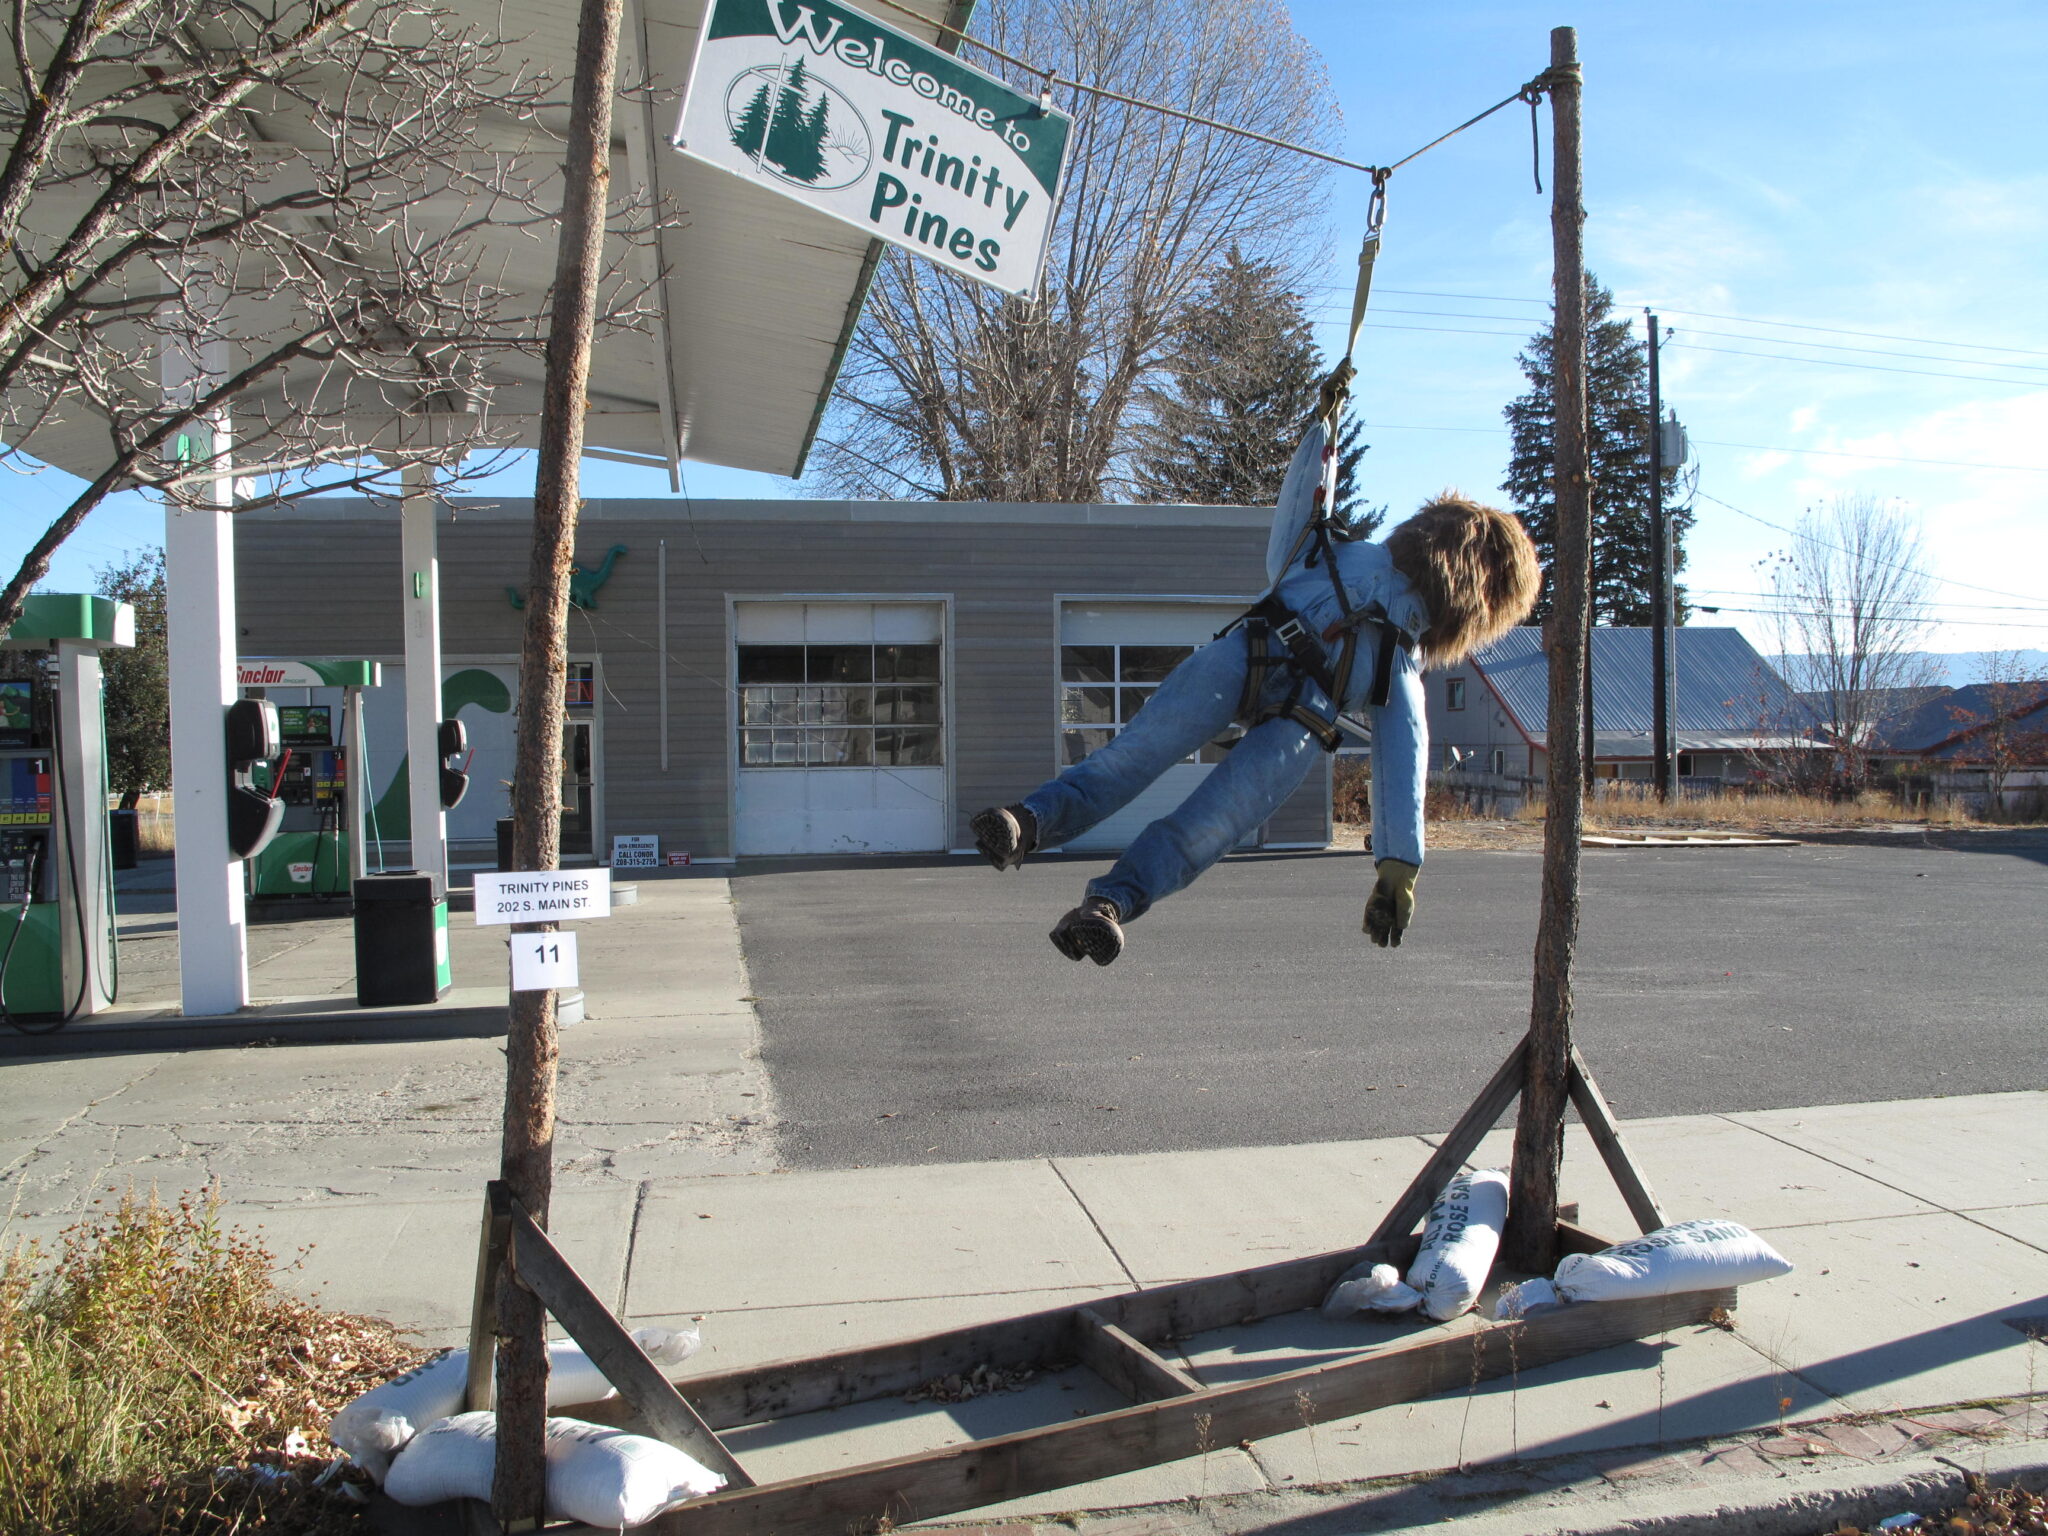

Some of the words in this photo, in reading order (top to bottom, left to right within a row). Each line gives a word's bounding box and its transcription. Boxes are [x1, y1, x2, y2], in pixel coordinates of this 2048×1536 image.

[765, 0, 996, 131] Welcome
[1003, 119, 1031, 152] to
[881, 108, 1030, 232] Trinity
[869, 171, 1001, 272] Pines
[499, 882, 549, 895] TRINITY
[552, 880, 589, 892] PINES
[497, 901, 520, 913] 202
[523, 900, 535, 912] S.
[538, 898, 570, 911] MAIN
[573, 897, 591, 908] ST.
[535, 944, 559, 964] 11
[1450, 1172, 1474, 1201] SAN
[1442, 1205, 1470, 1244] ROSE
[1687, 1225, 1749, 1243] SAND
